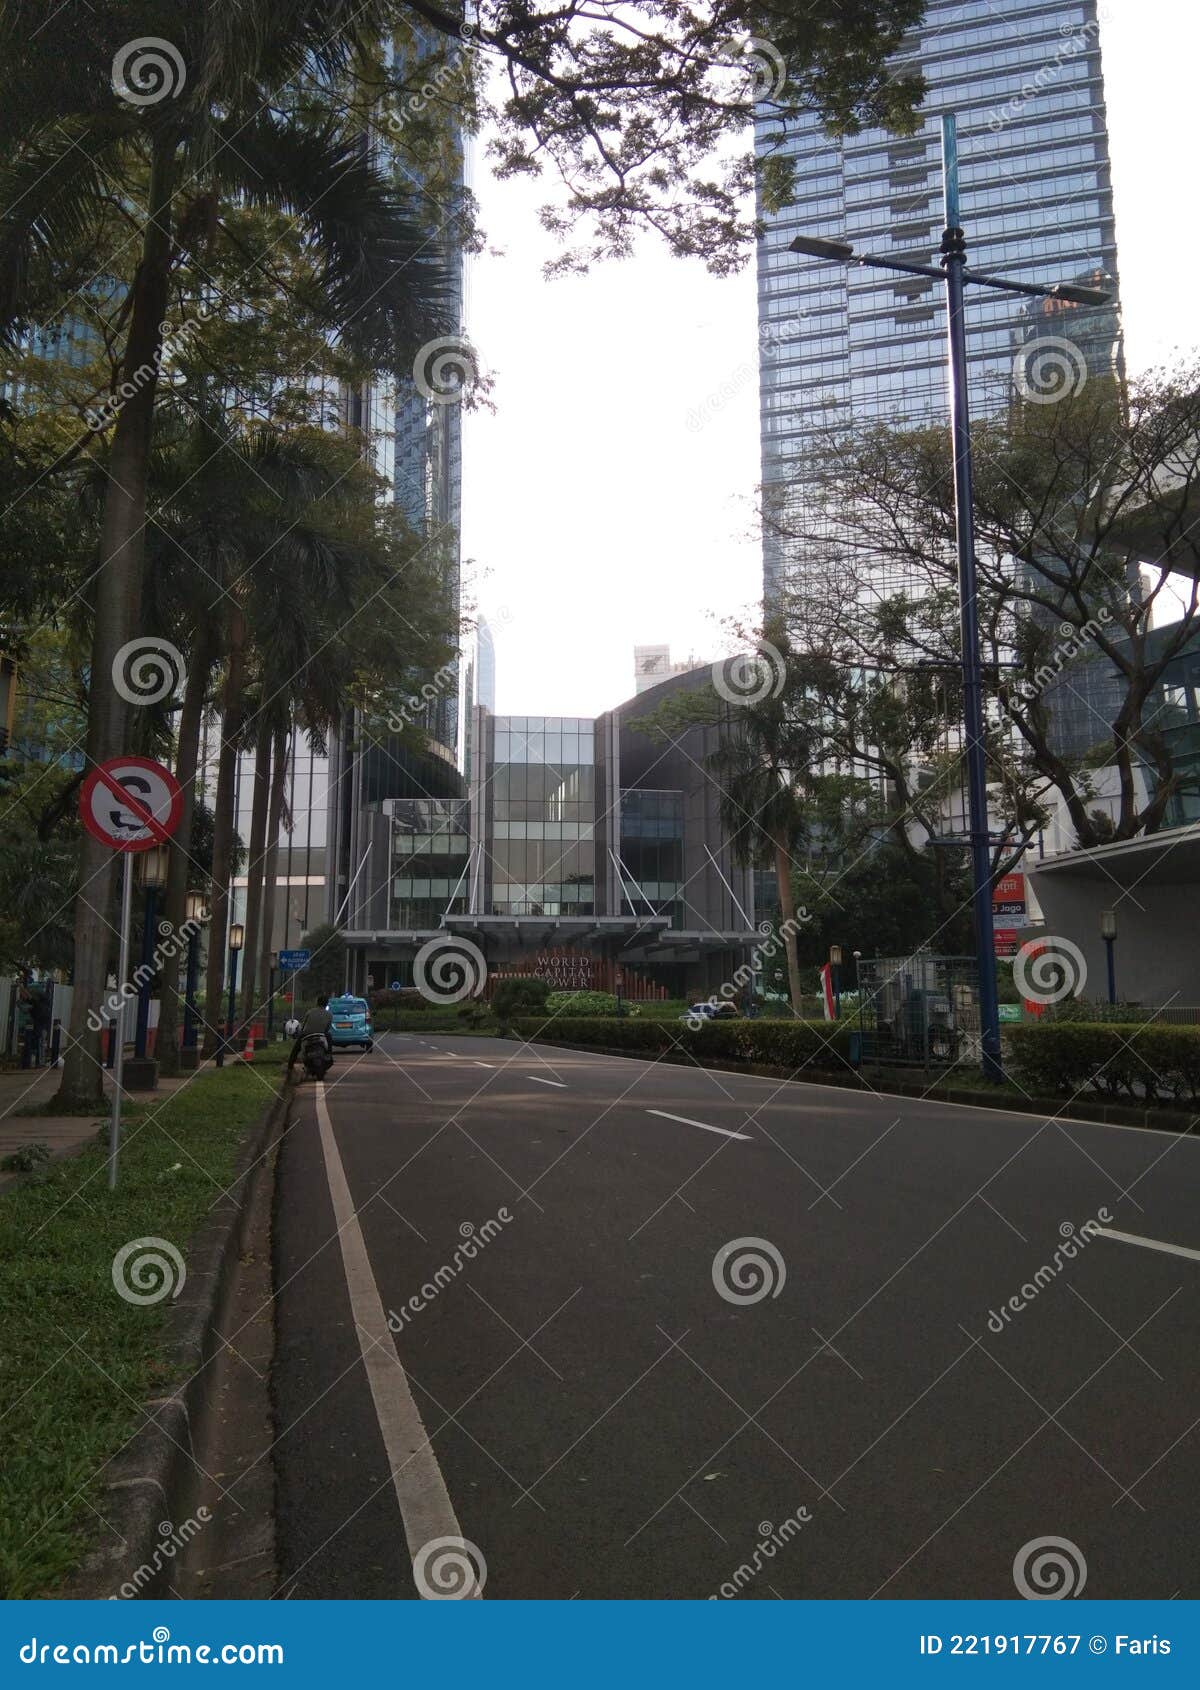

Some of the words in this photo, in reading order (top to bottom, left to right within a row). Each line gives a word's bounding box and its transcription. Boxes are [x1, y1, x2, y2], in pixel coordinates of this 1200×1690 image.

[1000, 904, 1022, 914] Jago
[537, 956, 589, 967] WORLD
[534, 967, 593, 978] CAPITAL
[546, 977, 589, 988] OWER
